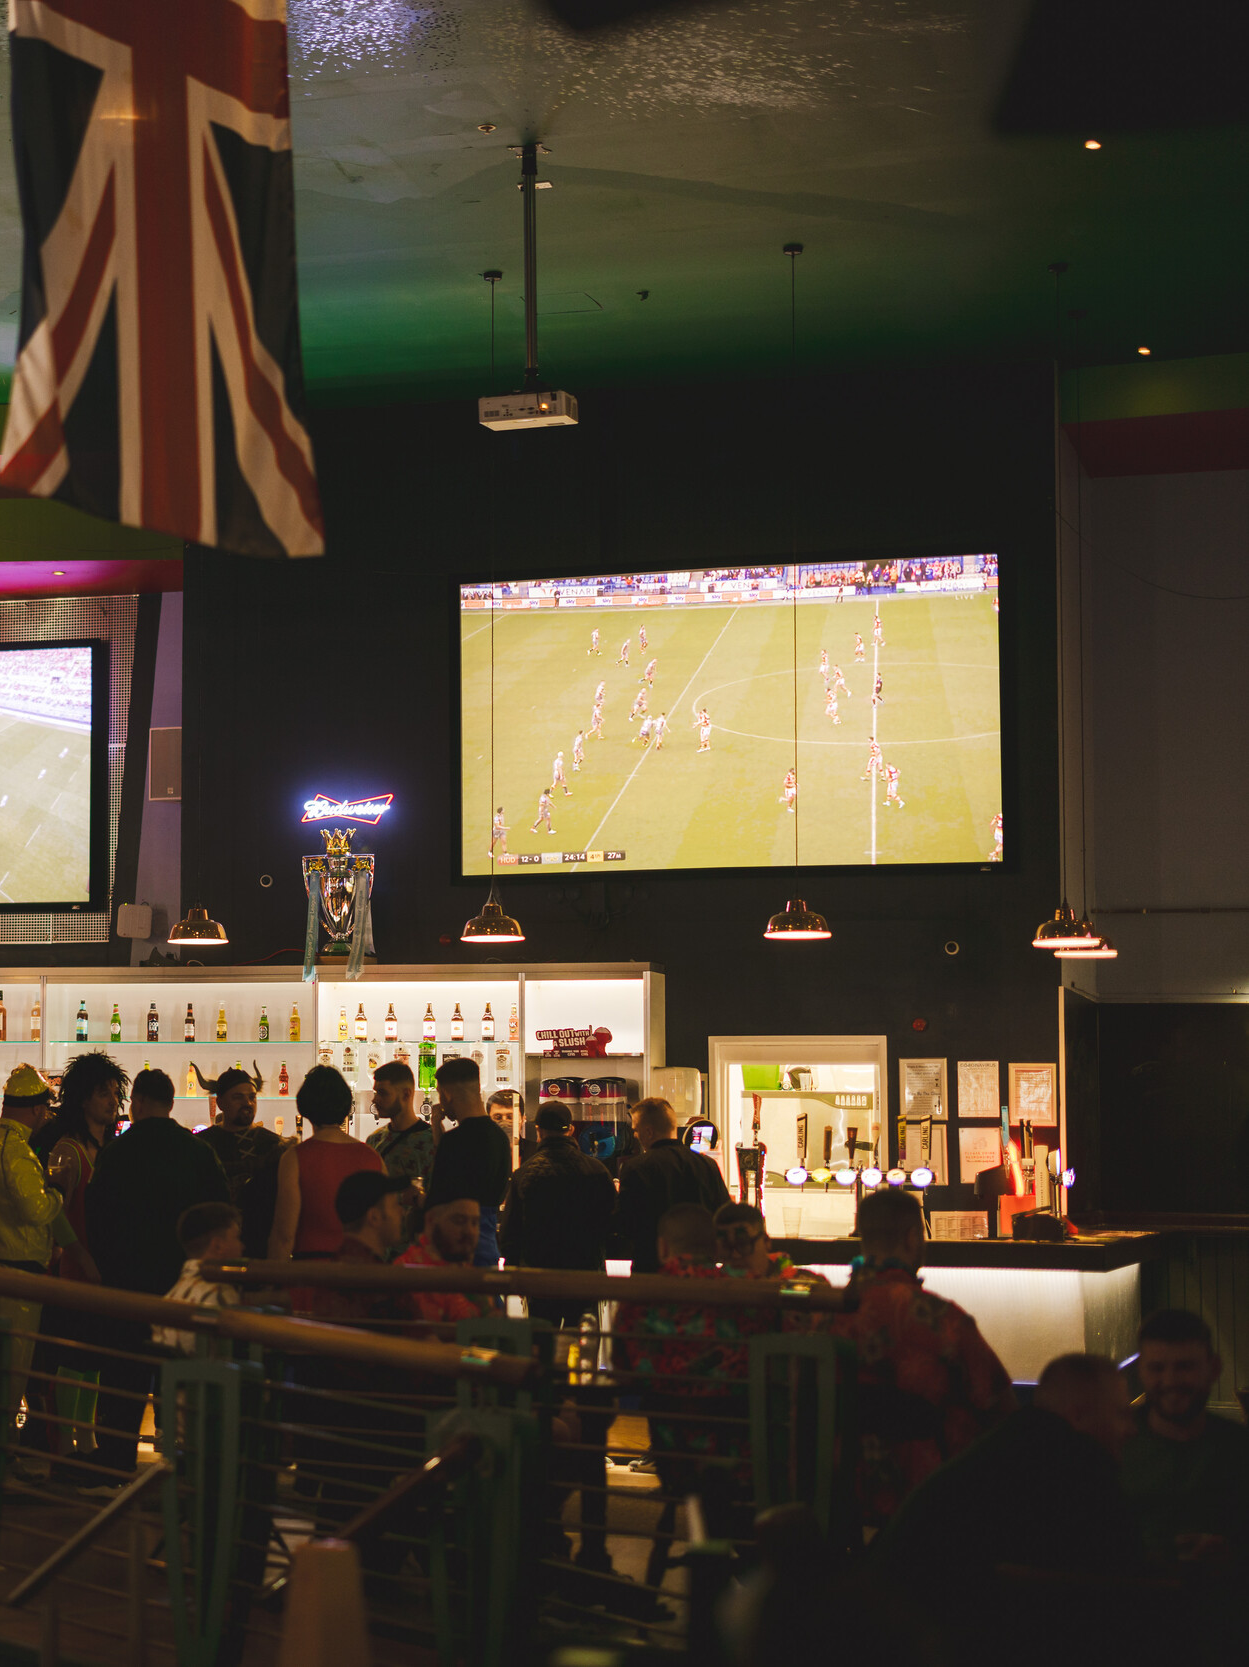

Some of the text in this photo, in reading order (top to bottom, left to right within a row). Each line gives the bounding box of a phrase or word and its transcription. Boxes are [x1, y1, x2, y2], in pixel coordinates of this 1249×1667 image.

[303, 799, 391, 819] Budweiser
[536, 1031, 558, 1040] CHILL
[559, 1029, 574, 1038] OUT
[558, 1037, 586, 1047] SLUSH
